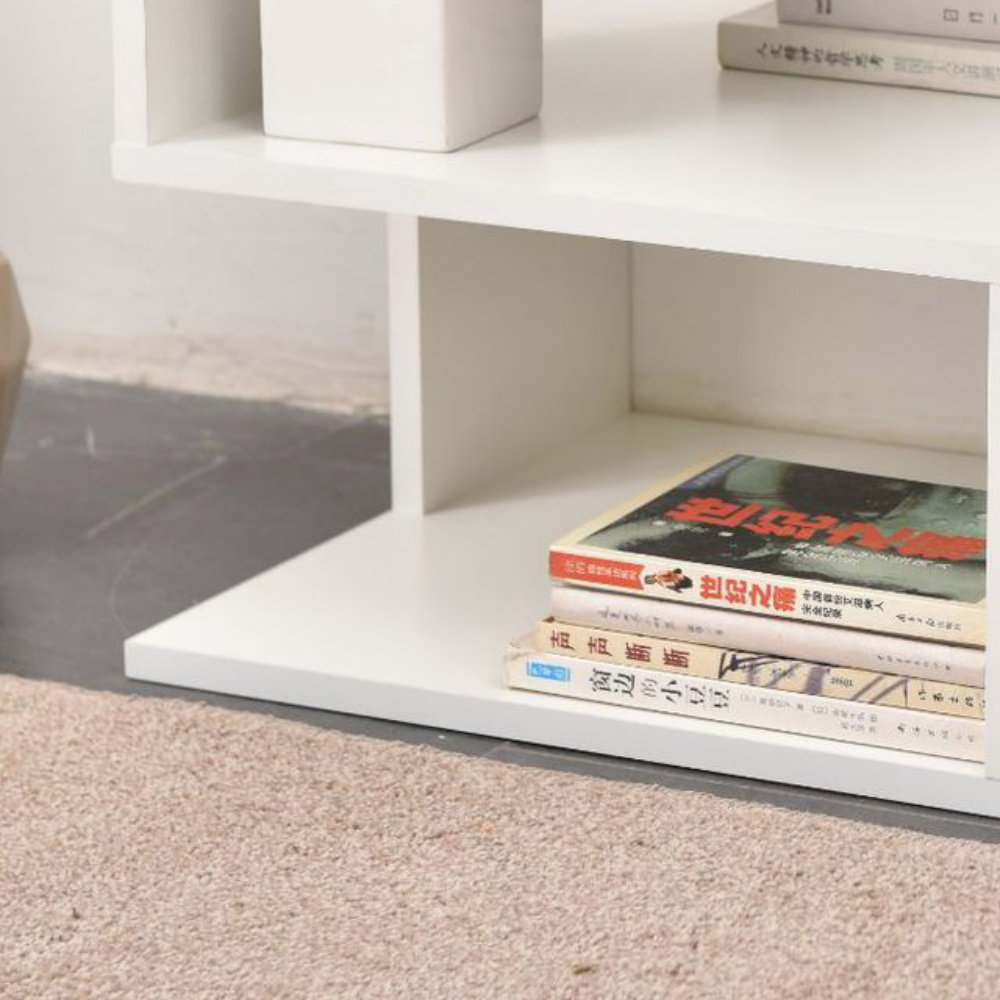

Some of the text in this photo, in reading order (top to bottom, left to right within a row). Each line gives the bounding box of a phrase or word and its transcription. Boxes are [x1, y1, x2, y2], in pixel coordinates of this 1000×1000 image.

[699, 574, 797, 612] 世纪之痛
[550, 630, 690, 669] 声声断断
[590, 668, 731, 708] 窗边的小豆豆
